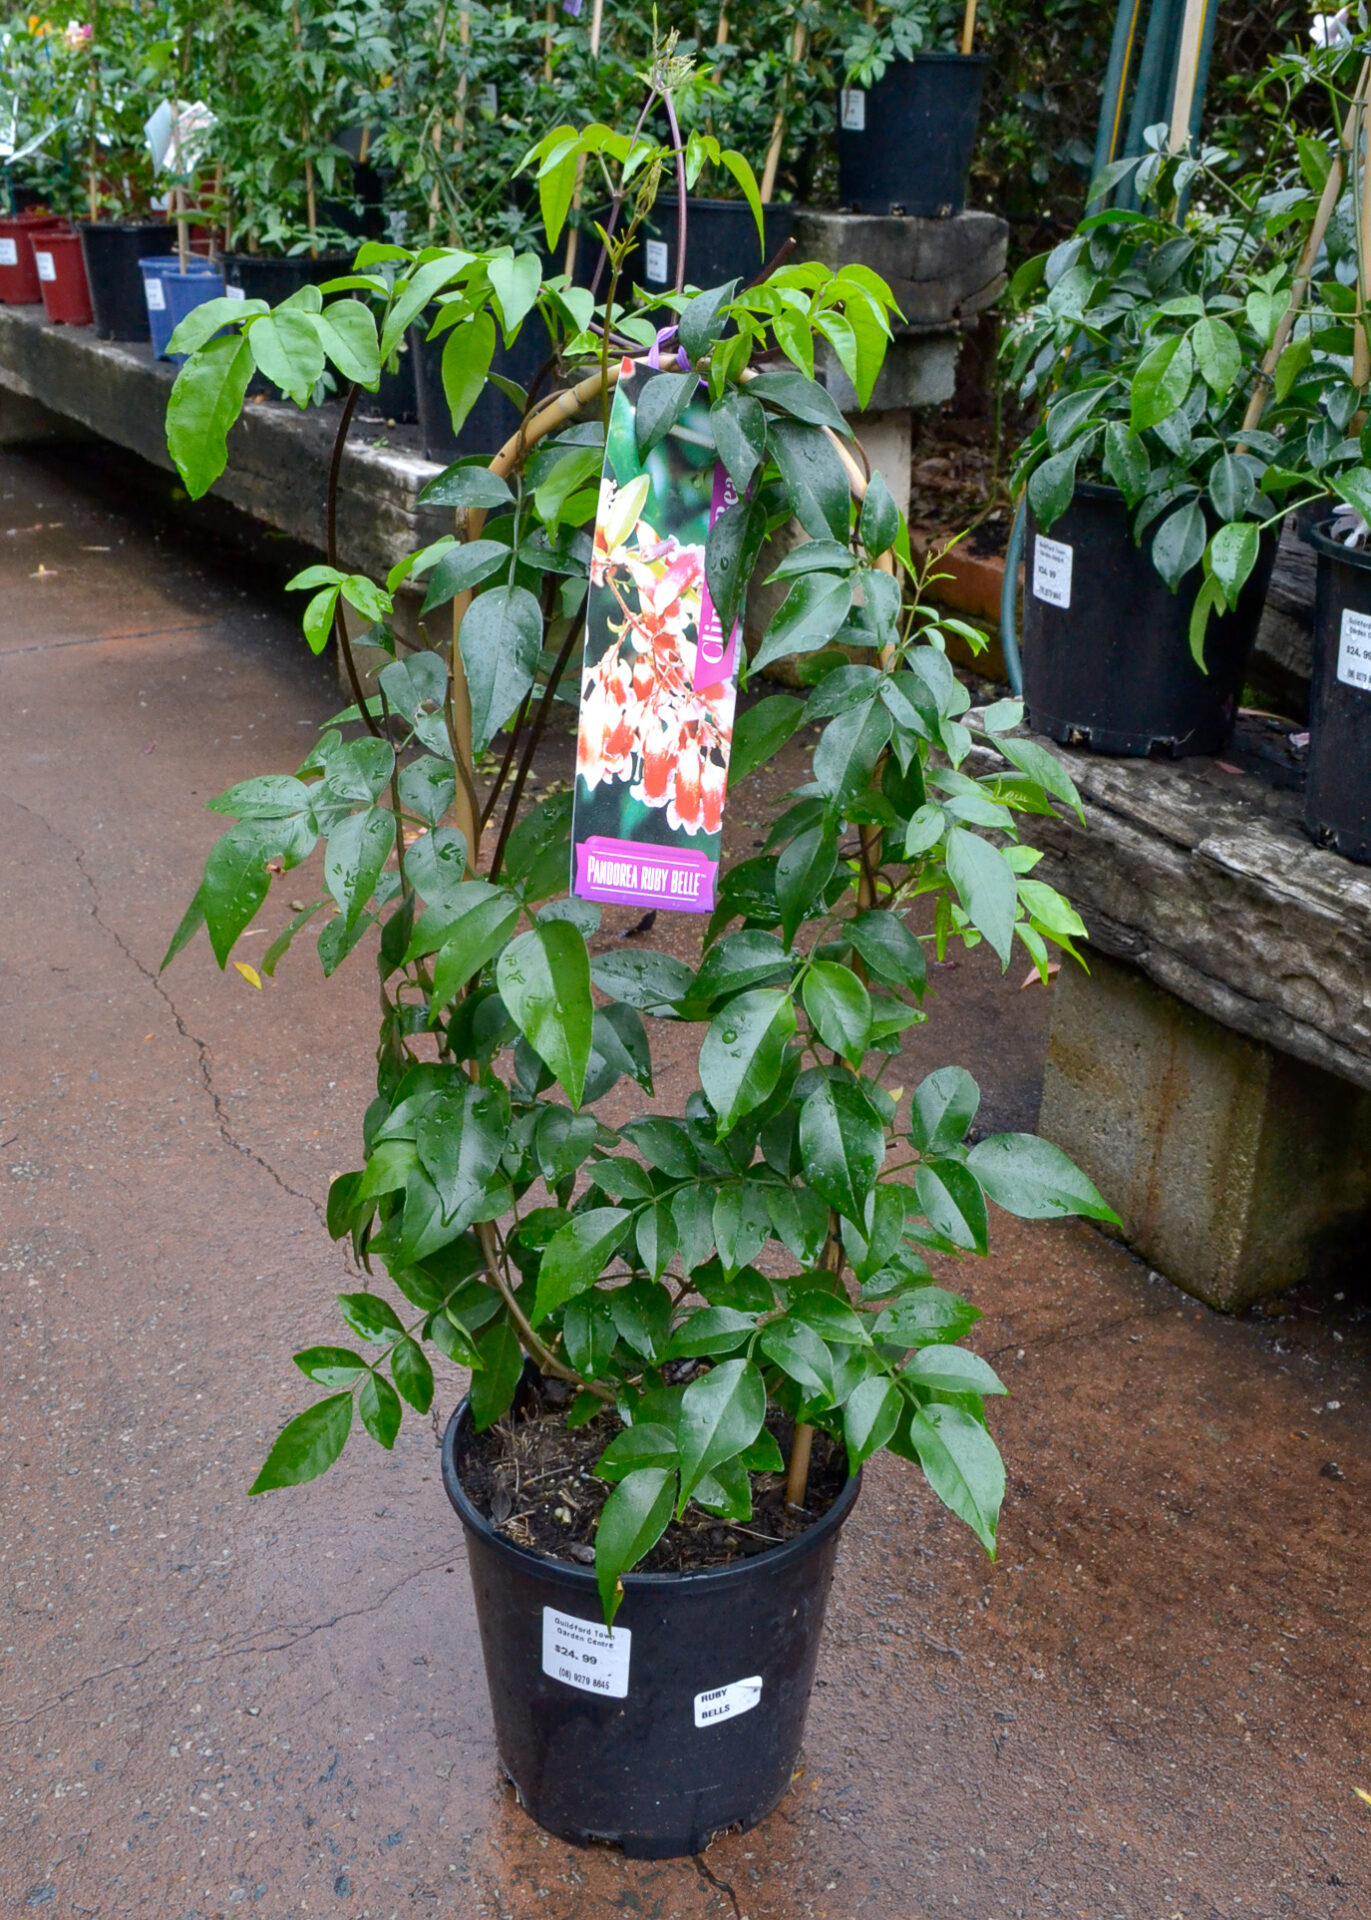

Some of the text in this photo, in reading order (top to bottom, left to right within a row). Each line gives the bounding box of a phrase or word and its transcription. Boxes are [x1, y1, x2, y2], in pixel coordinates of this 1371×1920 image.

[587, 855, 638, 889] PANDOREA
[640, 866, 669, 892] RUBY
[554, 1617, 592, 1636] Guildford
[556, 1627, 614, 1649] Garden Centre
[701, 1688, 728, 1703] RUBY
[701, 1704, 731, 1719] BELLS
